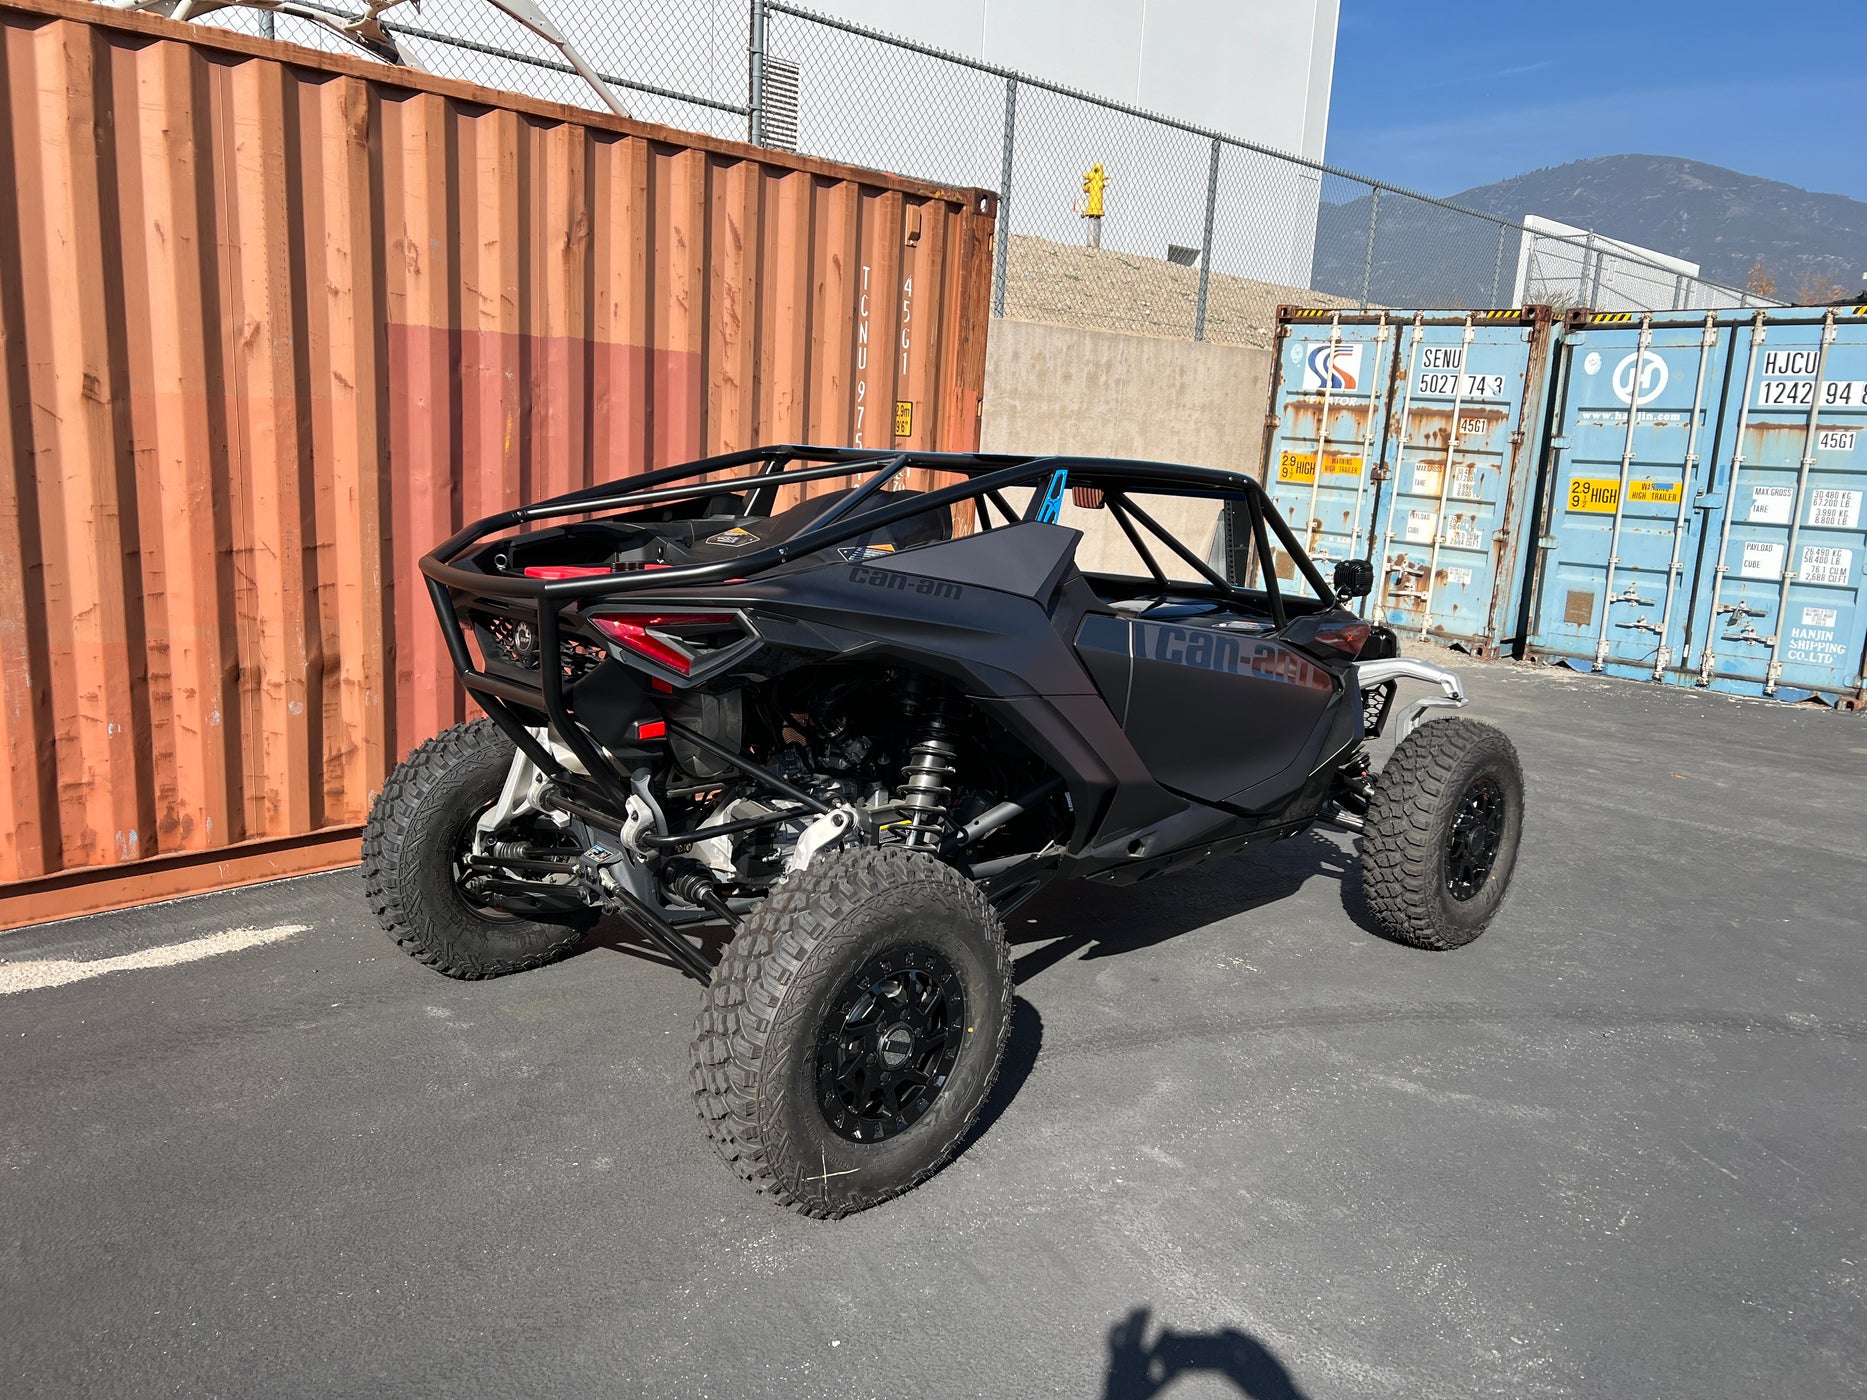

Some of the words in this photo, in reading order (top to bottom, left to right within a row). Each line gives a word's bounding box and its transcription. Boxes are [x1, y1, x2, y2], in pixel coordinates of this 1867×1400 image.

[859, 265, 870, 370] TCNU
[902, 275, 913, 375] 45G1
[1423, 348, 1462, 369] SENU
[1764, 351, 1819, 374] HJCU
[1419, 373, 1459, 394] 5027
[1468, 375, 1487, 396] 74
[1764, 381, 1813, 404] 1242
[1825, 382, 1853, 405] 94
[1582, 411, 1681, 421] www.hajin.com
[1461, 419, 1486, 433] 45G1
[1820, 432, 1855, 449] 45G1
[1296, 461, 1316, 476] HIGH
[1590, 487, 1618, 504] HIGH
[1631, 491, 1647, 500] HIGH
[1651, 493, 1677, 502] TRAILER
[1753, 504, 1769, 513] TARE
[1746, 543, 1773, 552] PAYLOAD
[1743, 560, 1761, 568] CUBE
[848, 567, 963, 600] can-am
[1791, 628, 1834, 641] HANJIN
[1789, 639, 1847, 654] SHIPPING
[1156, 624, 1314, 688] can-am
